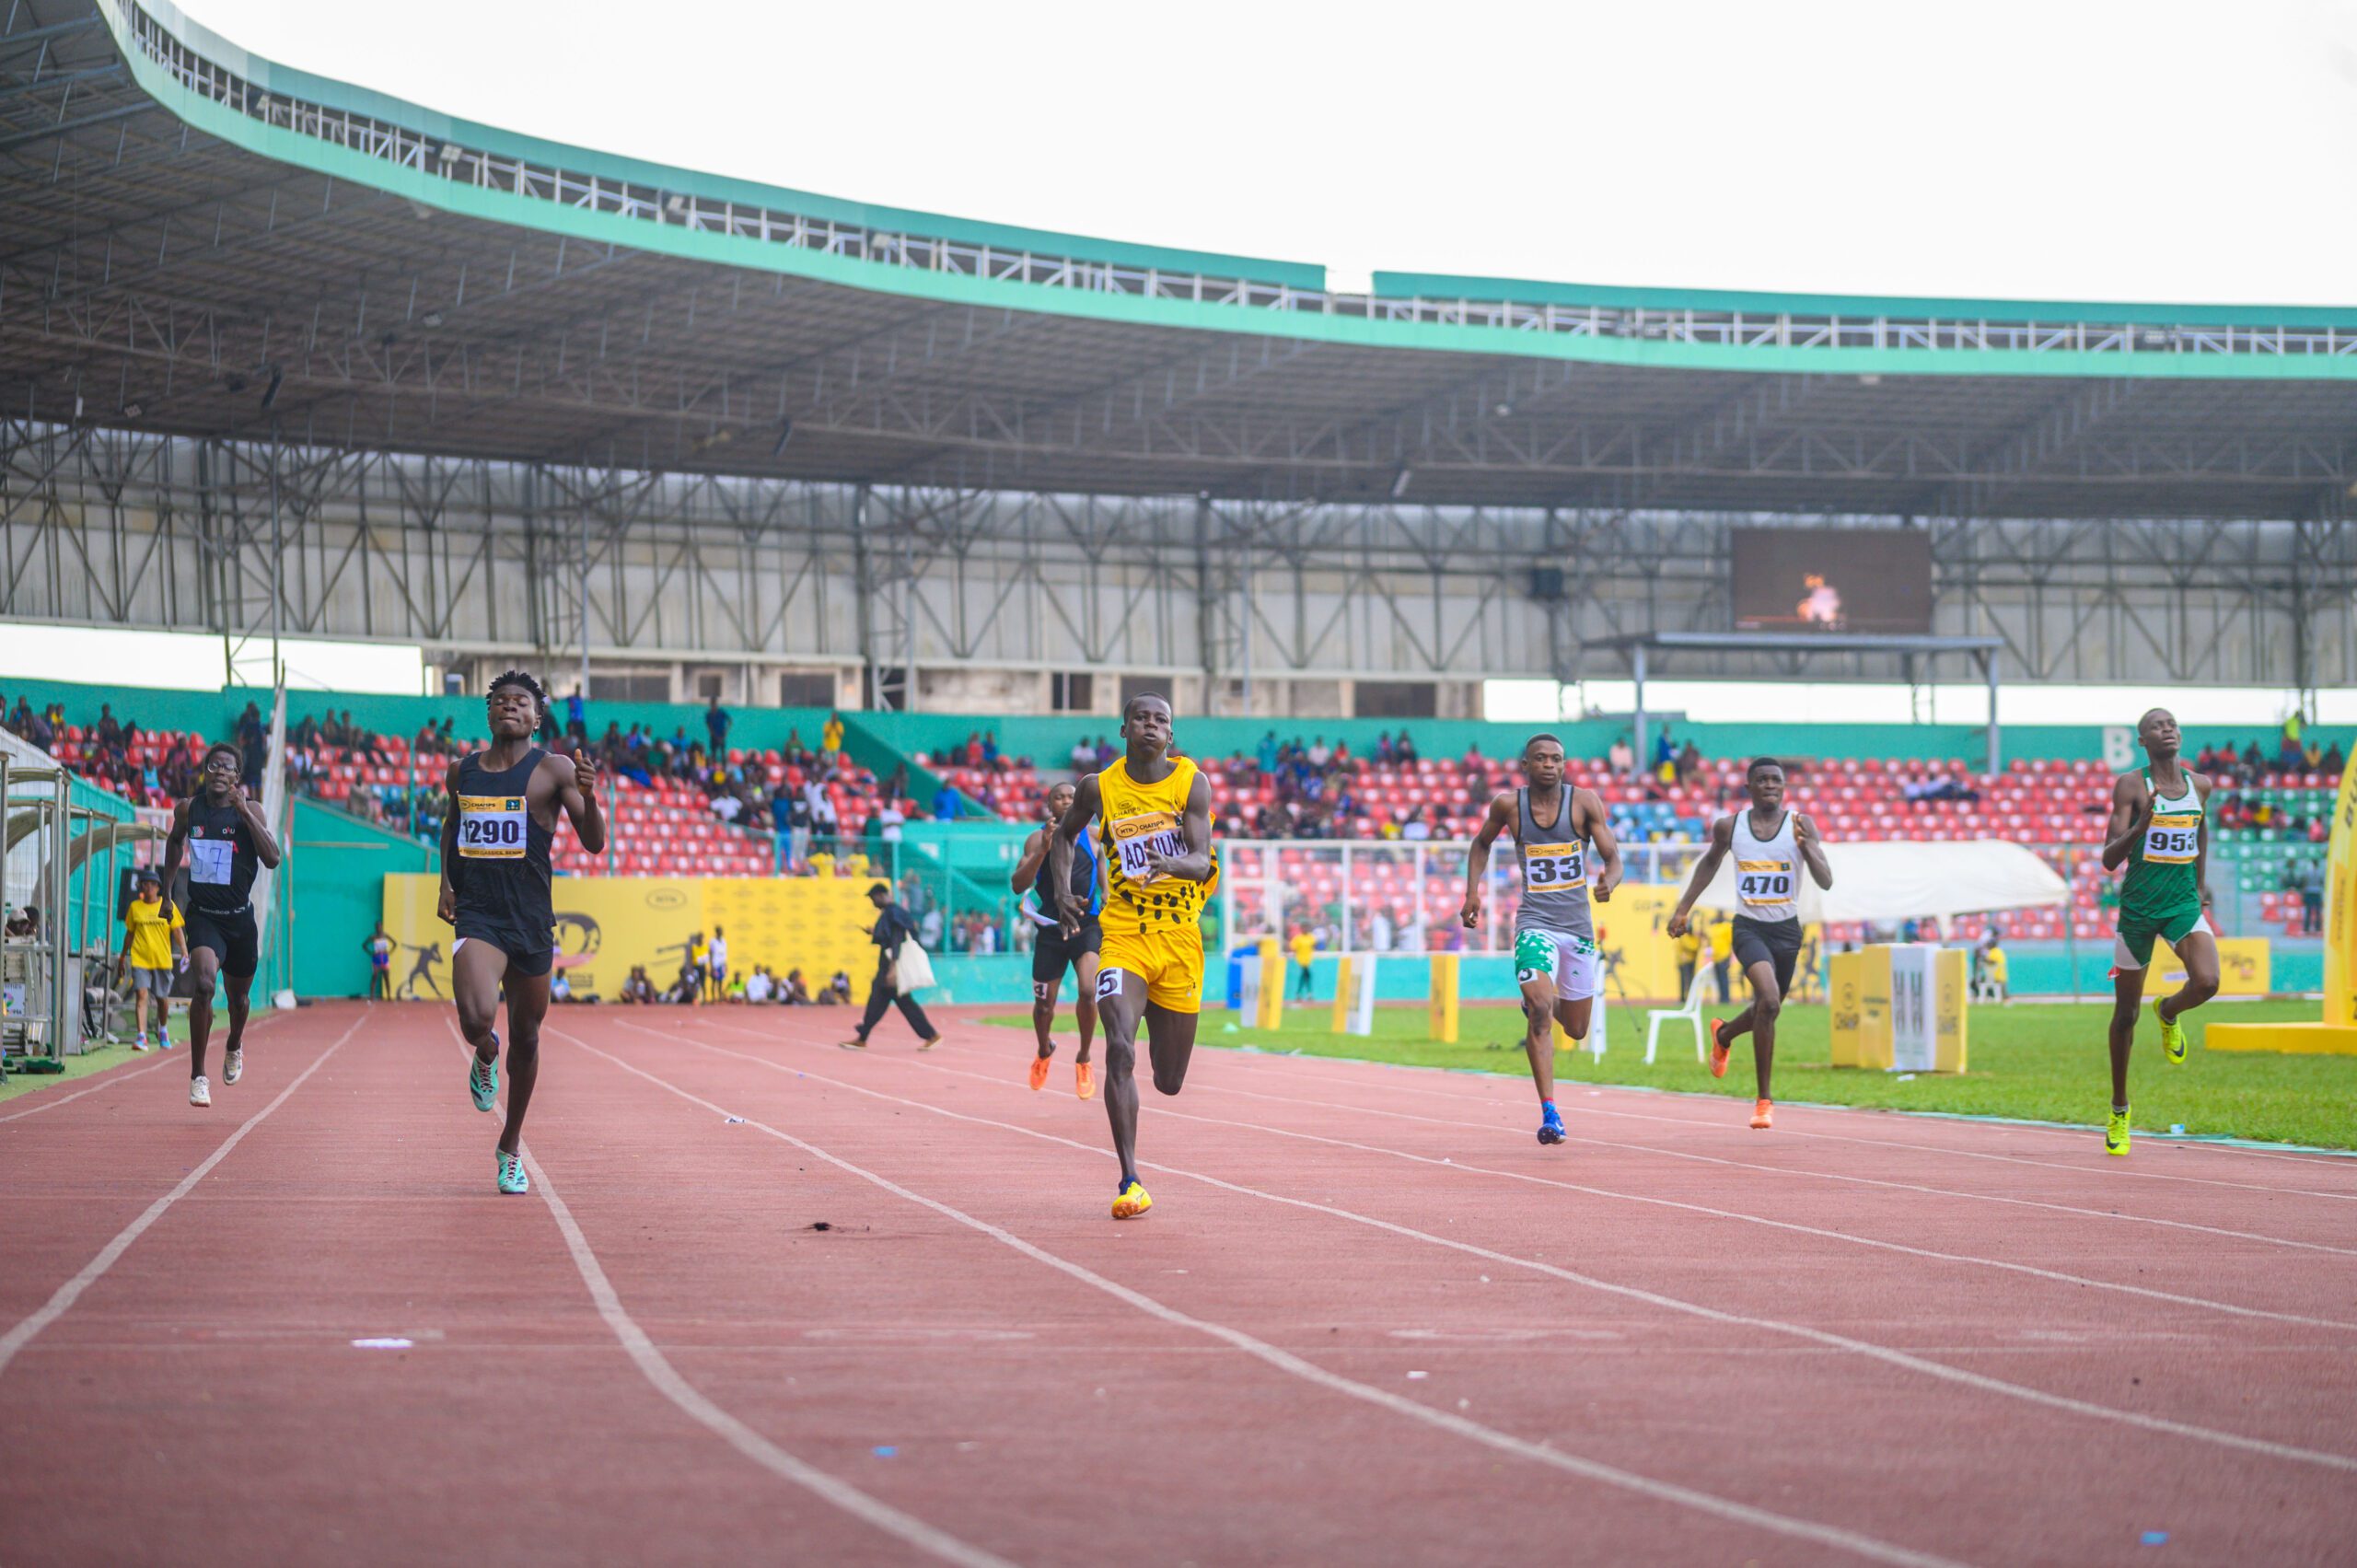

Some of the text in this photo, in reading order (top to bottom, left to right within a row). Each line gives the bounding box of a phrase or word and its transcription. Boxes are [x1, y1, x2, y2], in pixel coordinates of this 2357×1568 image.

[2103, 726, 2135, 770] B
[463, 819, 519, 844] 1290
[1139, 819, 1165, 830] CHAMPS
[1530, 855, 1582, 883] 33
[1741, 876, 1789, 894] 470
[1034, 984, 1045, 997] 4
[1098, 969, 1118, 996] 5
